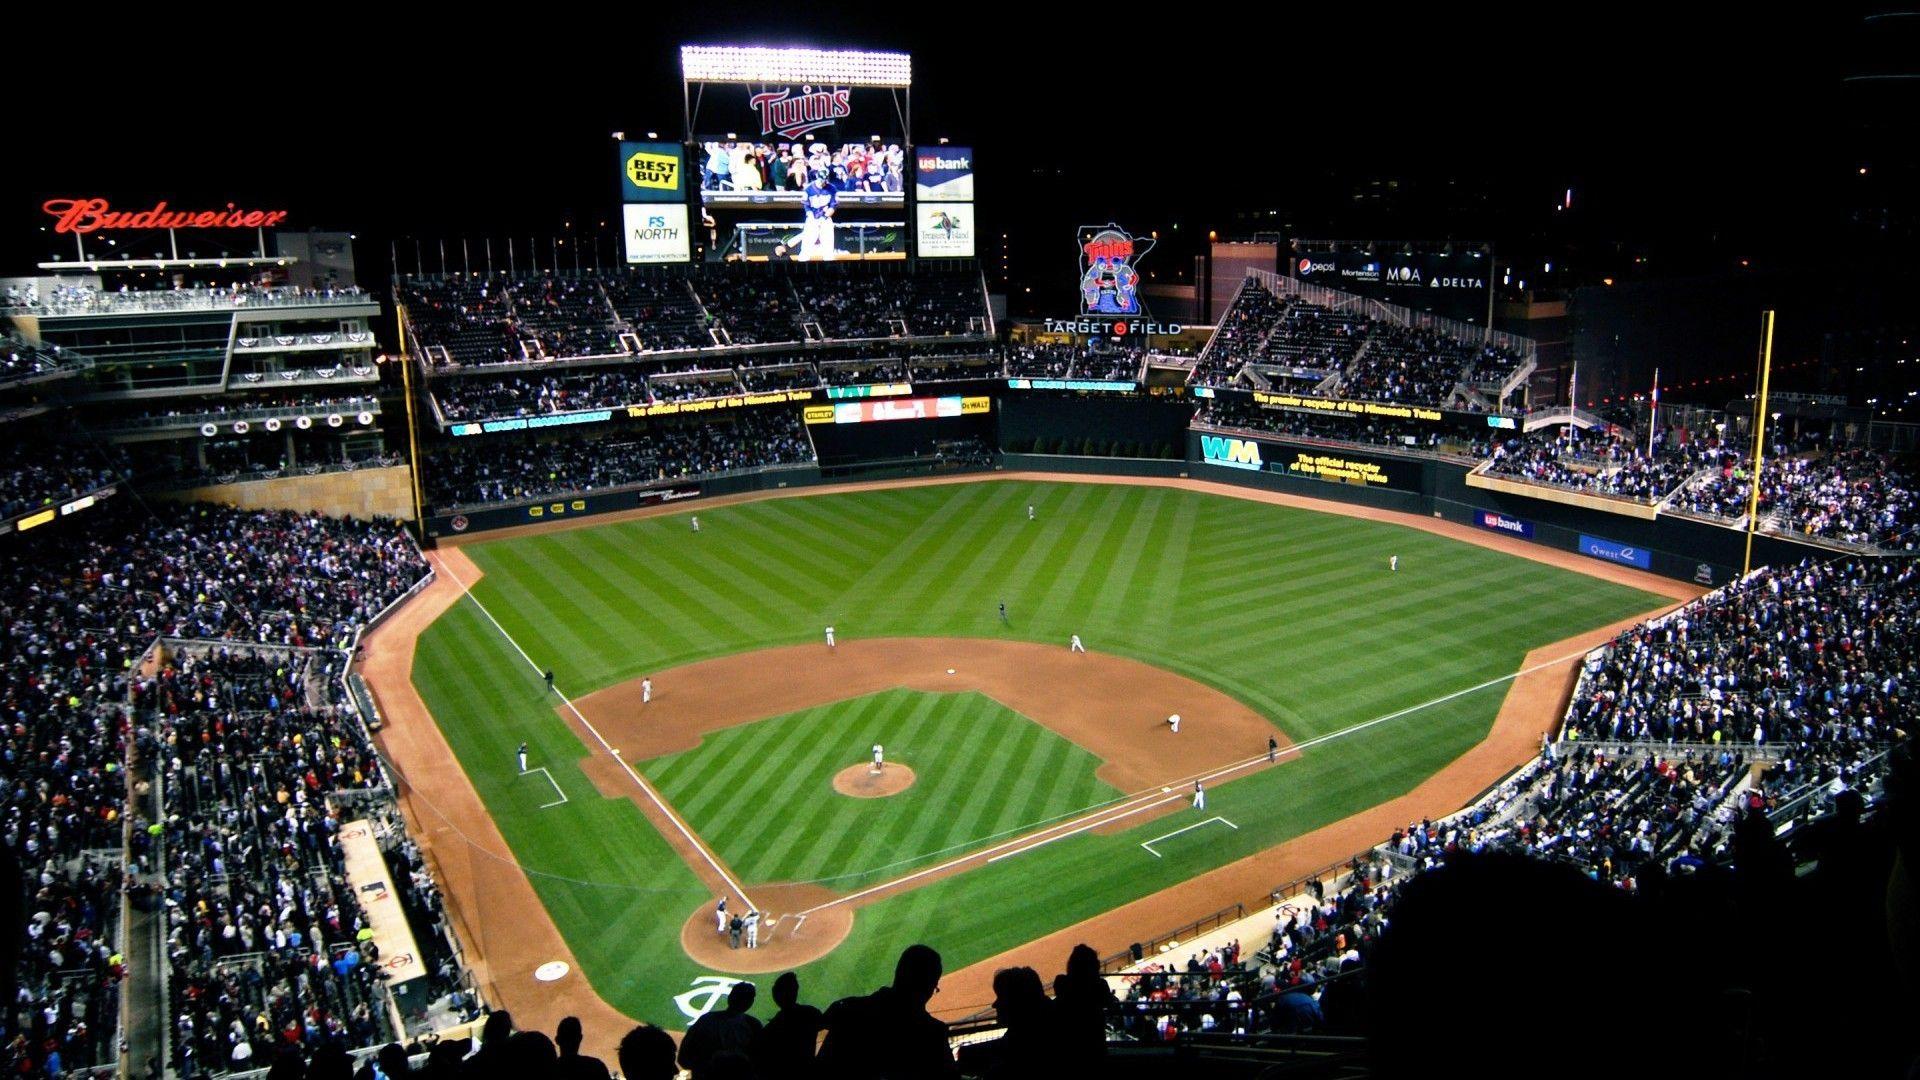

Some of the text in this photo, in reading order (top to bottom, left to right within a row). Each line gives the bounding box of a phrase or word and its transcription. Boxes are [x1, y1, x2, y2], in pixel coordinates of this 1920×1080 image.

[750, 85, 850, 136] Twins
[634, 159, 677, 173] BEST
[636, 171, 673, 184] BUY
[43, 198, 287, 234] Budweiser
[634, 229, 678, 240] NORTH
[1311, 262, 1335, 272] pepsi
[1342, 269, 1380, 277] Mortenson
[1442, 278, 1482, 288] DELTA
[1044, 321, 1181, 334] TARGET FIELD
[627, 407, 646, 417] The
[647, 403, 679, 416] official
[717, 399, 728, 408] of
[728, 397, 743, 407] the
[787, 391, 812, 401] Twins
[1253, 392, 1268, 403] The
[1269, 395, 1301, 406] premier
[1302, 398, 1336, 410] recycler
[1337, 401, 1348, 410] of
[1348, 402, 1363, 412] the
[1413, 408, 1441, 421] Twins
[1201, 436, 1262, 465] WM
[1298, 454, 1380, 473] The official recycler
[1290, 462, 1387, 484] of the Minnesota Twins
[1590, 545, 1620, 560] Qwest
